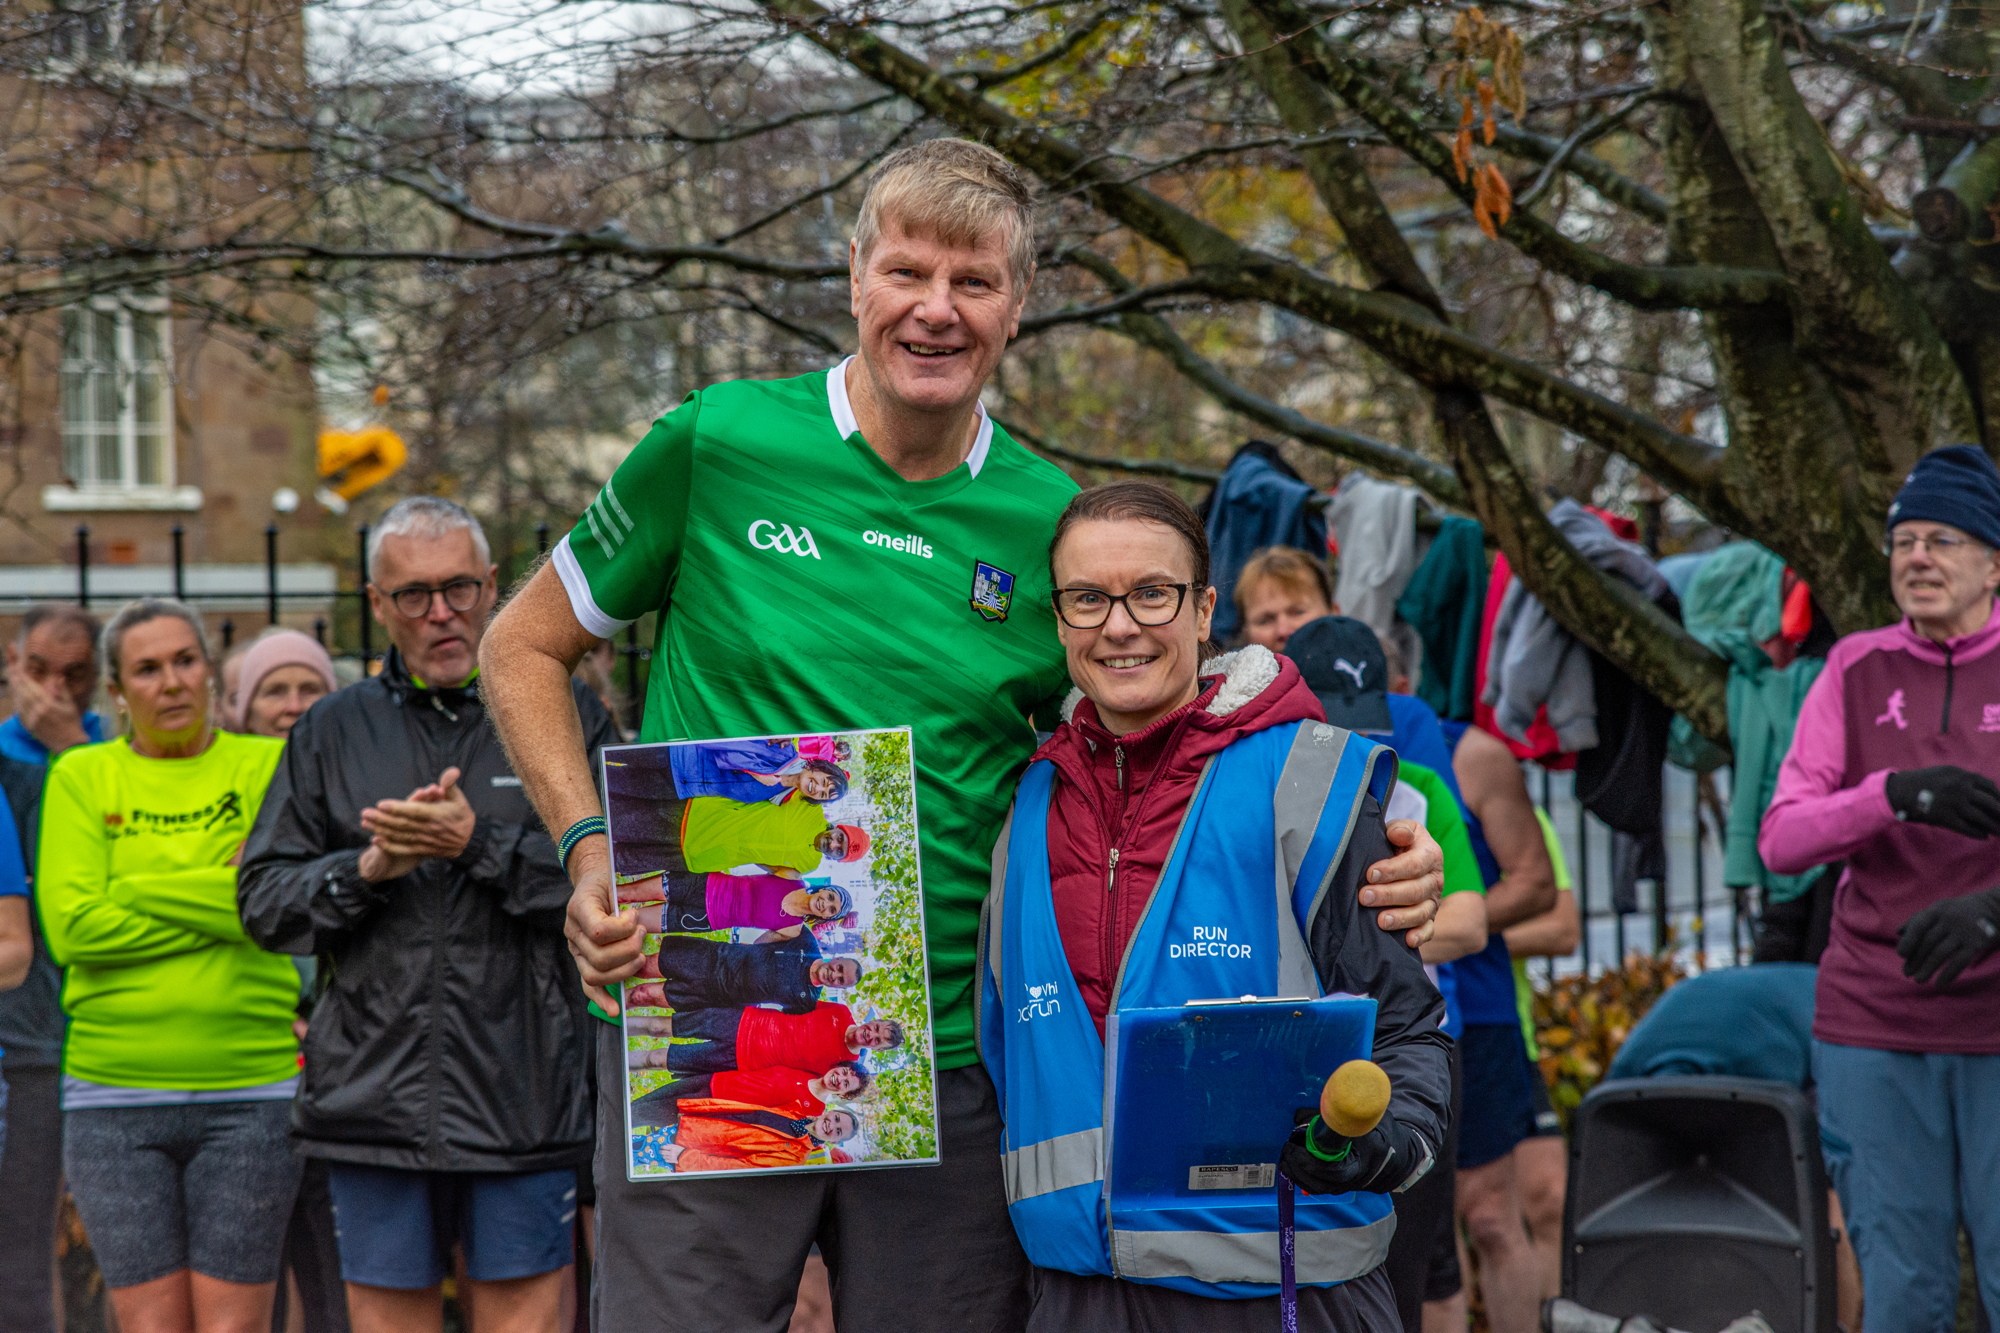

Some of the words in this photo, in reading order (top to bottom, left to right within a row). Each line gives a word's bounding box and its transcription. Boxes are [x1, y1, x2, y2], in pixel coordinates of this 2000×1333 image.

[747, 519, 822, 560] GAA
[132, 804, 214, 825] FITNESS
[1193, 926, 1228, 942] RUN
[1170, 942, 1252, 959] DIRECTOR
[1041, 981, 1059, 997] Vhi
